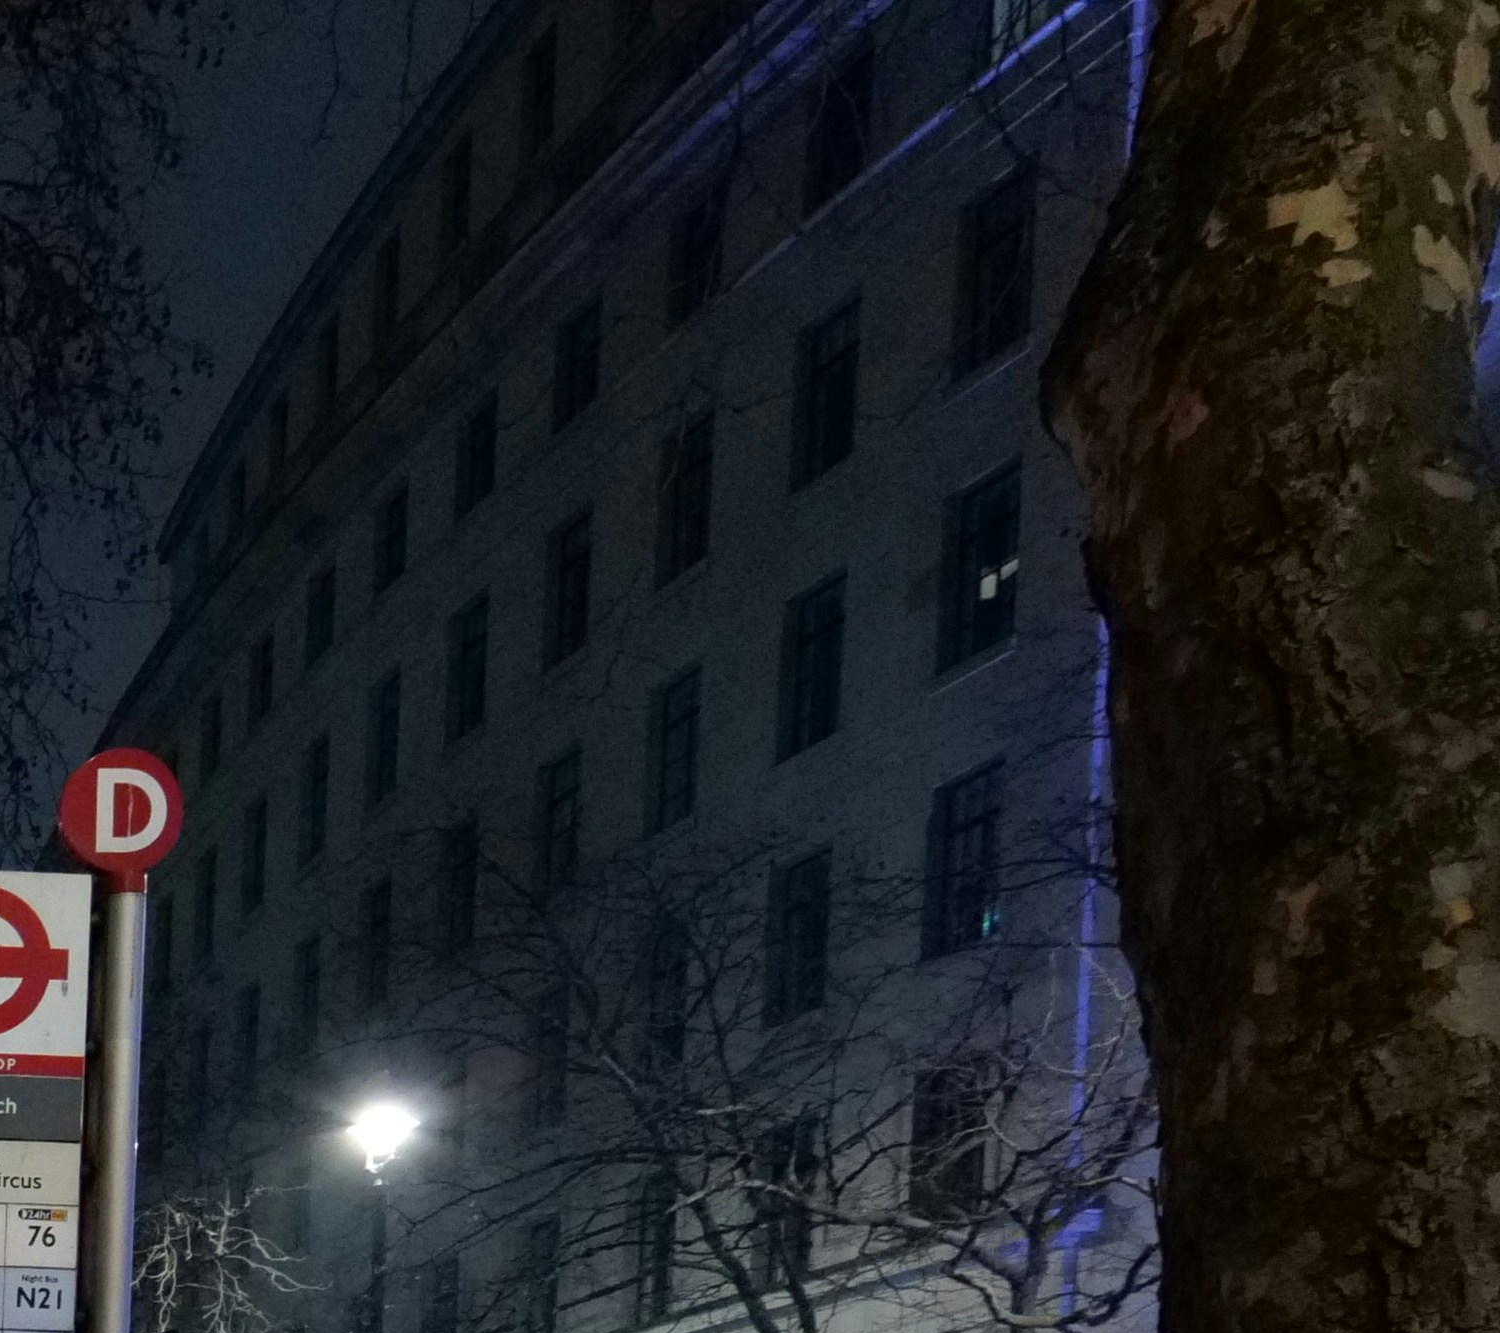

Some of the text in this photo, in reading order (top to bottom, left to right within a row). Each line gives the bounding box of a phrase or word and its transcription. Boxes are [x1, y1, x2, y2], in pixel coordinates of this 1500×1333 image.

[95, 767, 168, 853] D
[27, 1225, 56, 1247] 76
[16, 1287, 62, 1309] N21
